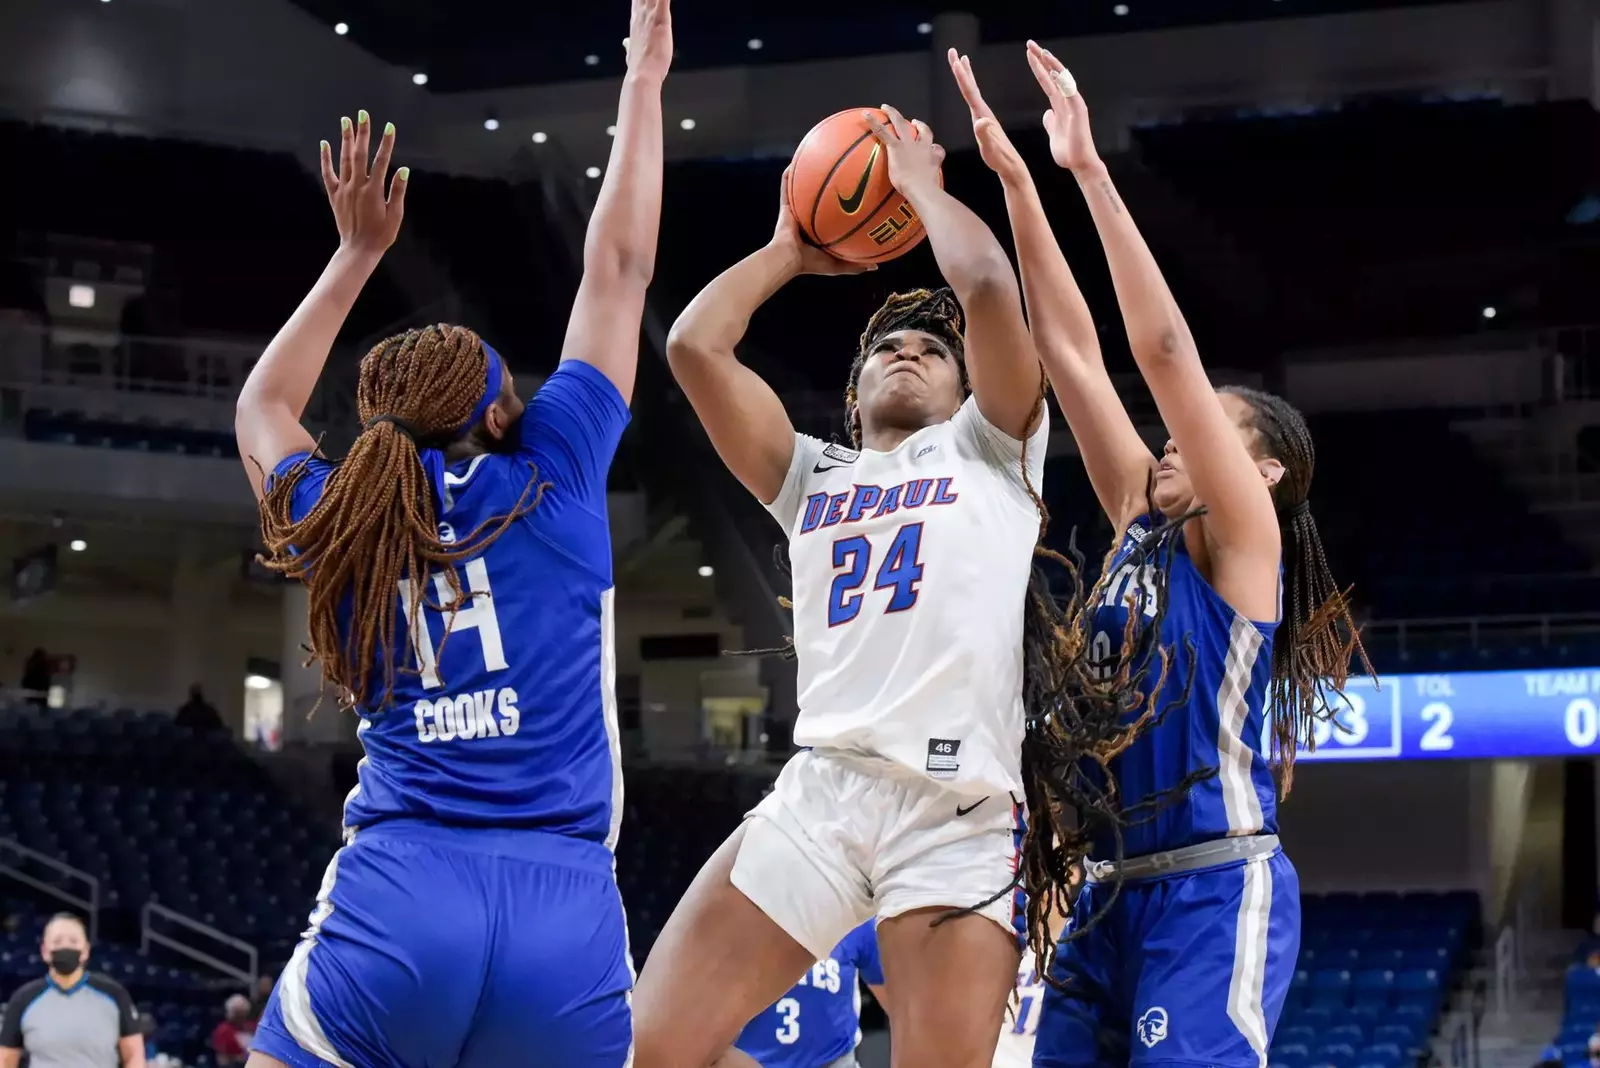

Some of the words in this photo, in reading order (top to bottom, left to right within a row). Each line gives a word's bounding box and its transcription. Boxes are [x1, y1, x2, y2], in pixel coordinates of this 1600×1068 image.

[867, 199, 914, 246] ELI
[828, 522, 924, 628] 24
[398, 557, 509, 690] 14
[1413, 675, 1455, 697] TOL
[1523, 672, 1588, 696] TEAM
[414, 687, 520, 743] COOKS
[1420, 701, 1454, 751] 2
[1564, 698, 1598, 748] 0
[935, 743, 952, 753] 46
[797, 958, 841, 994] ES
[775, 998, 800, 1044] 3
